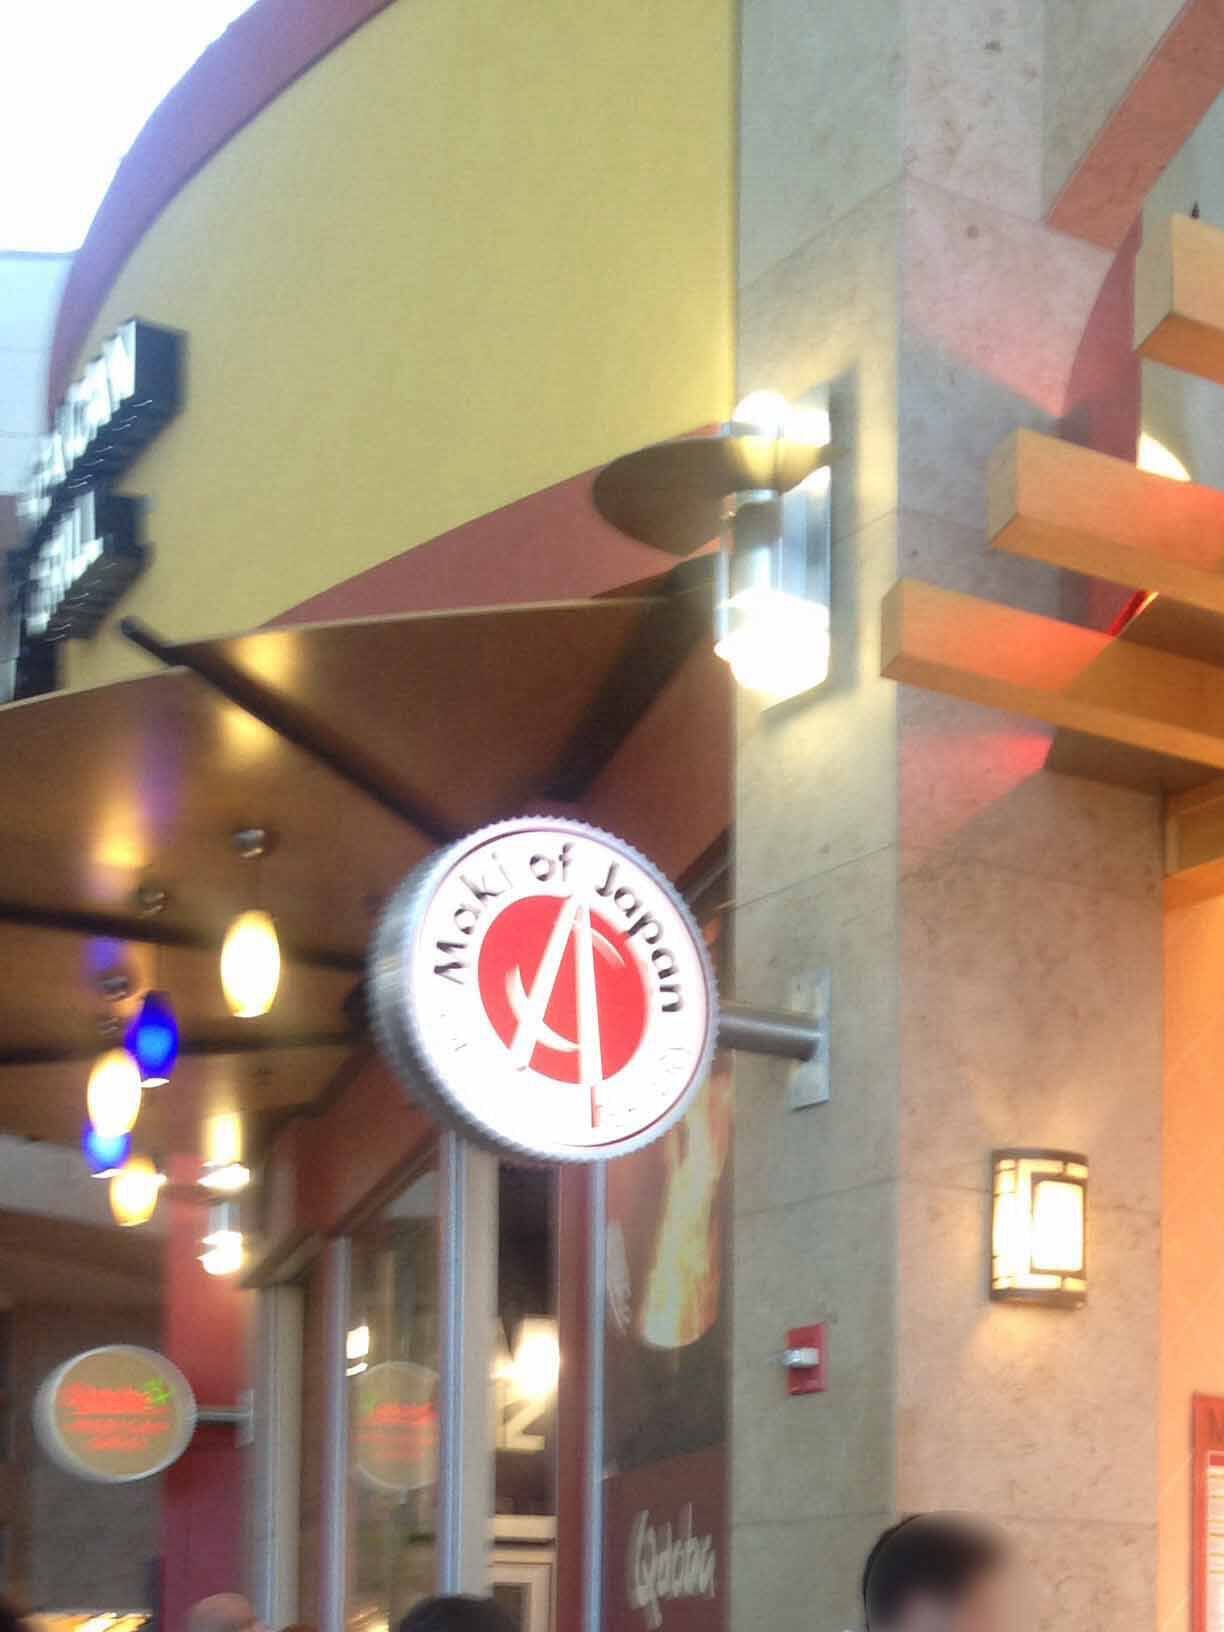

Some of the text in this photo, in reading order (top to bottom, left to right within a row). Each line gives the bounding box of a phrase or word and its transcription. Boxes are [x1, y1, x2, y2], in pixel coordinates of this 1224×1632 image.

[433, 842, 685, 1014] Maki of Japan
